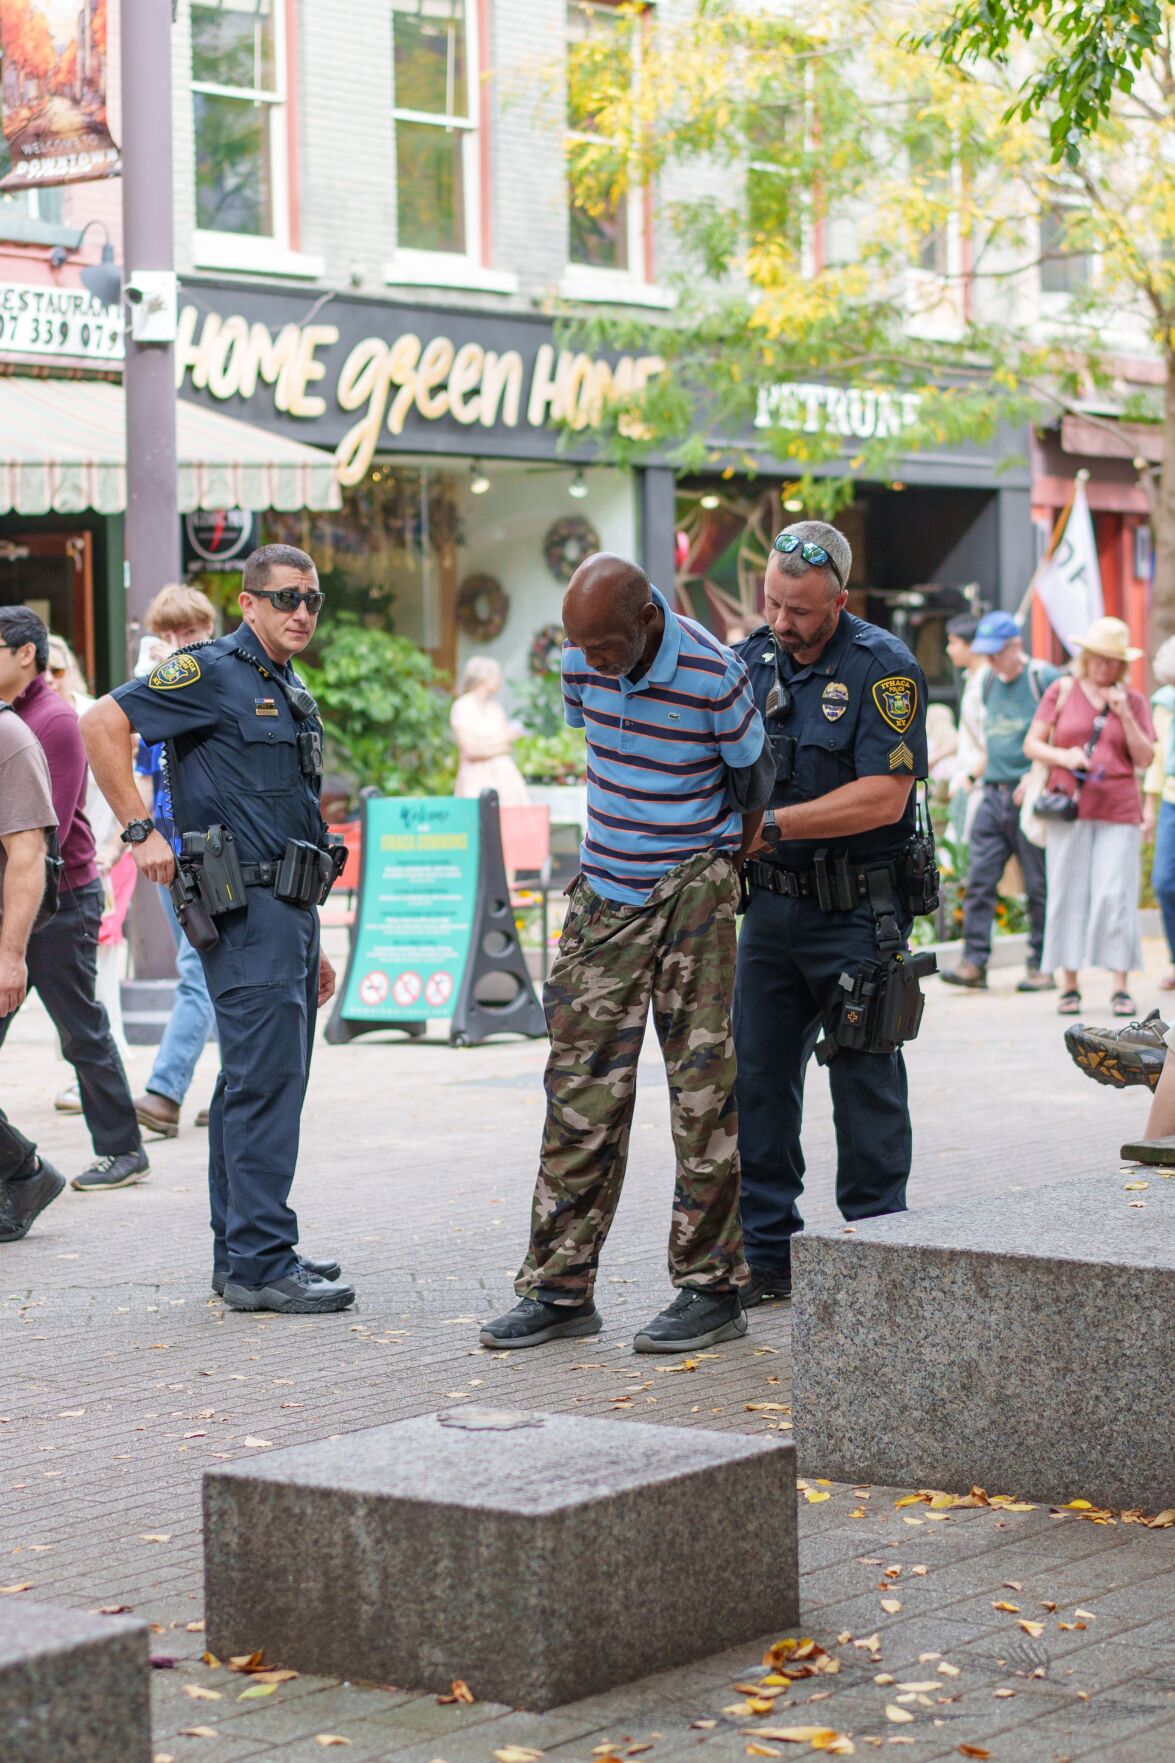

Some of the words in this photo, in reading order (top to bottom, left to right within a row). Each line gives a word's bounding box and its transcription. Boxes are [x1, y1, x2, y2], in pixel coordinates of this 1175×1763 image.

[21, 139, 80, 155] WELCOME
[82, 133, 99, 147] TO
[16, 148, 119, 177] DOWNTOWN
[30, 318, 69, 346] 339
[175, 306, 339, 417] HOME
[334, 333, 523, 487] green
[881, 680, 911, 689] ITHACA
